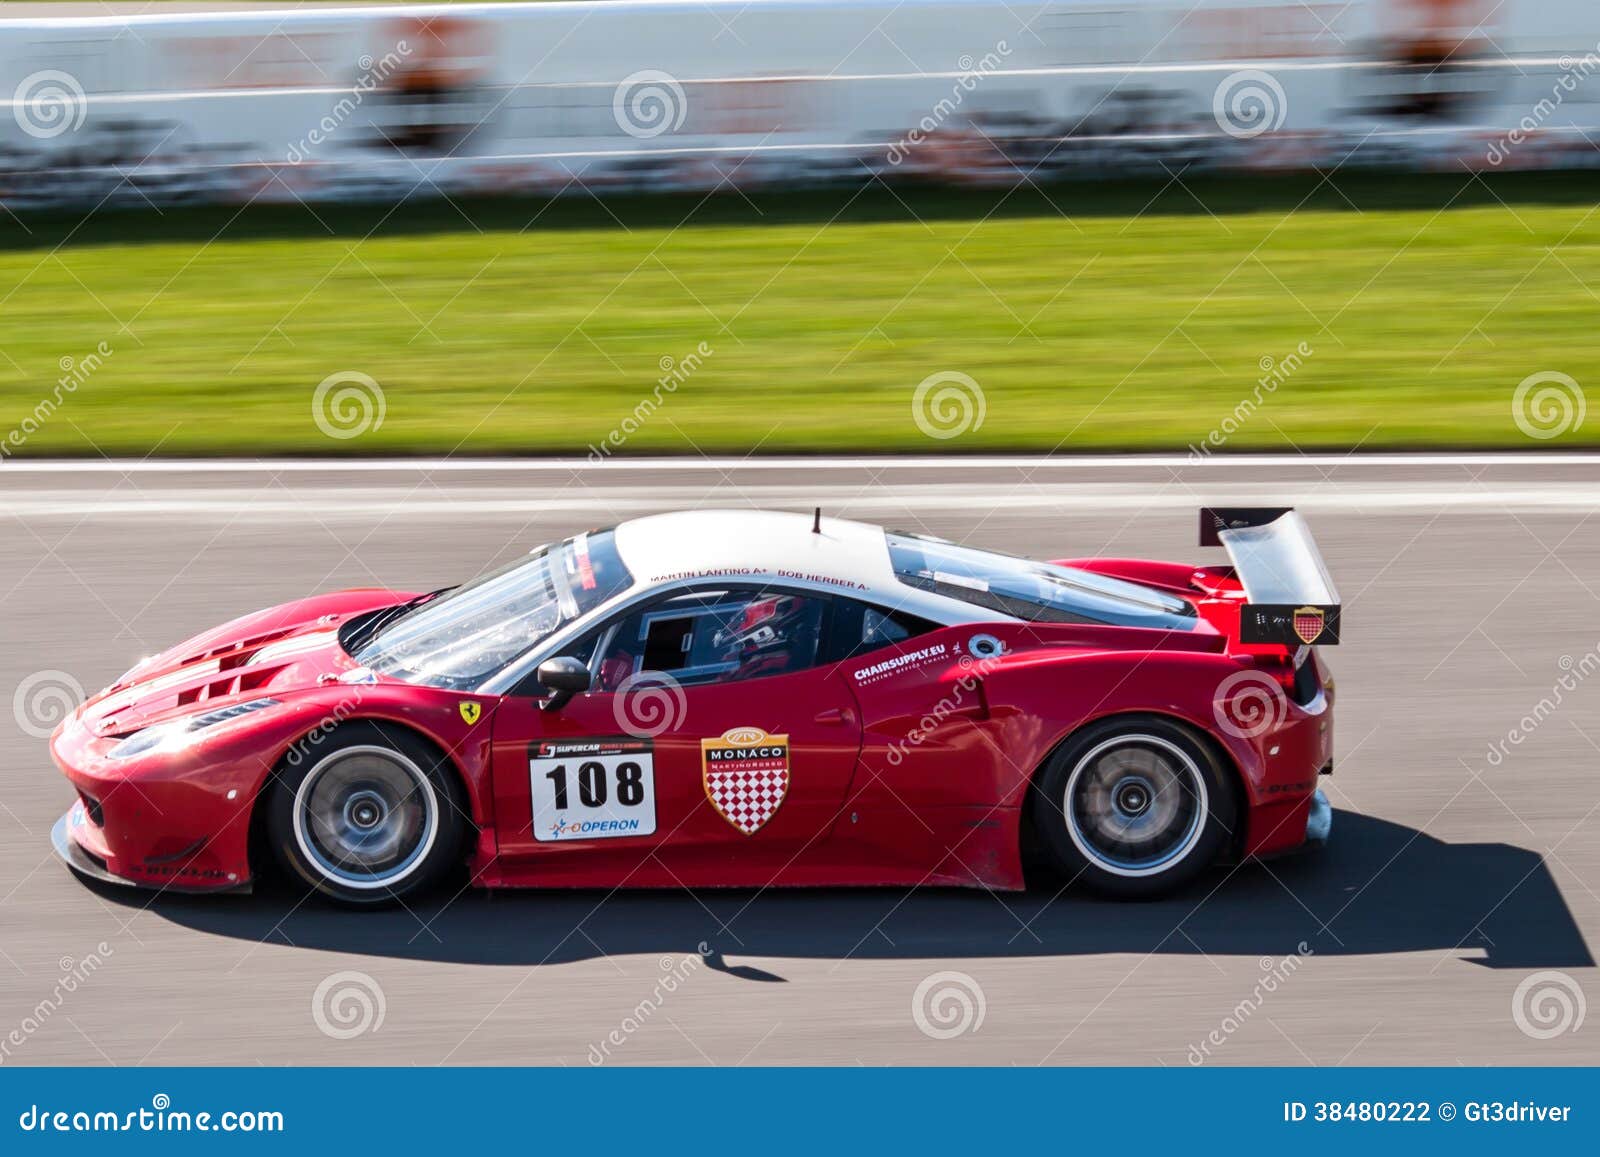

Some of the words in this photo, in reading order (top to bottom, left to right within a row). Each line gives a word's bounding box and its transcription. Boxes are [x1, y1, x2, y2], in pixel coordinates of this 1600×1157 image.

[650, 571, 695, 582] MARTIN
[698, 567, 750, 577] LANTING
[777, 569, 803, 579] BOB
[806, 574, 856, 589] HERBER
[854, 644, 946, 680] CHAIRSUPPLY.EU
[556, 743, 600, 754] SUPERCAR
[711, 747, 782, 760] MONACO
[545, 761, 645, 810] 108
